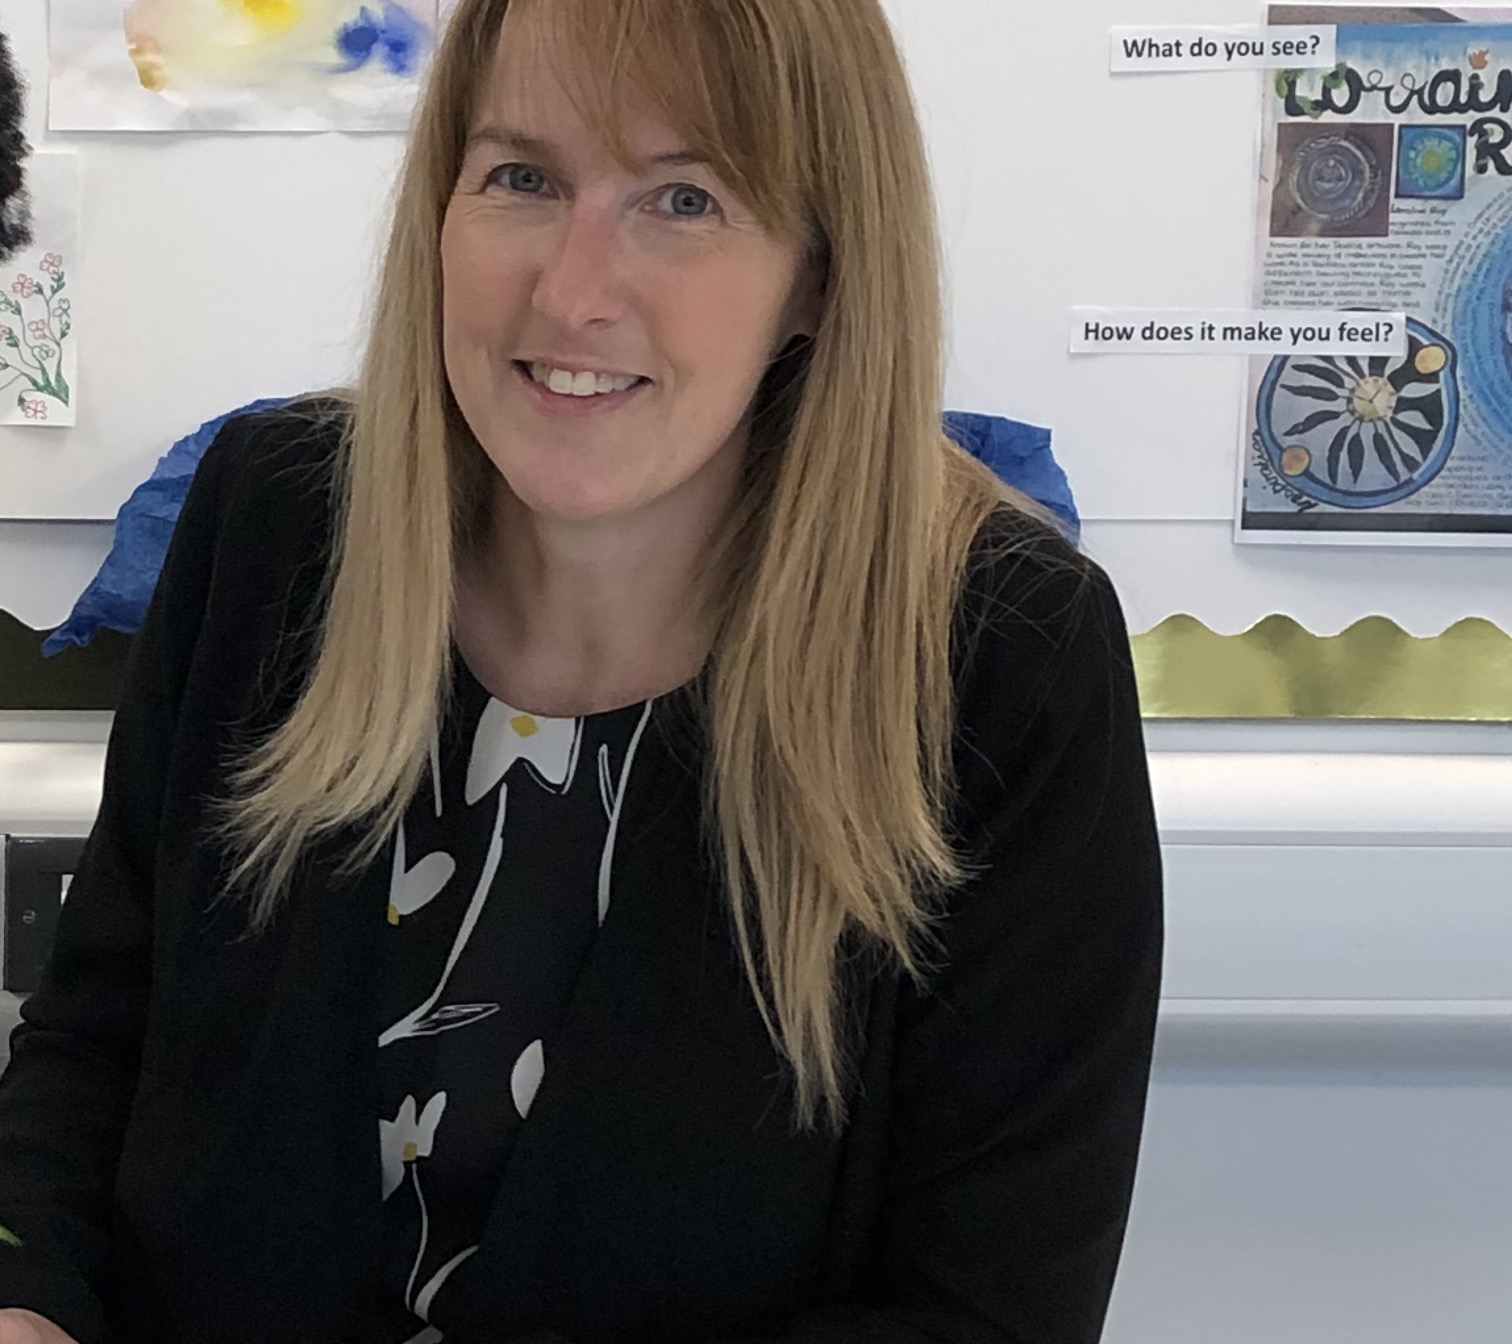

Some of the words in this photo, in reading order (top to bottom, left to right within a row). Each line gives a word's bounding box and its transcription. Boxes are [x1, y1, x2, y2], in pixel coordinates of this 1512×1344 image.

[1122, 37, 1183, 59] What
[1189, 36, 1218, 58] do
[1224, 41, 1265, 61] you
[1270, 34, 1321, 56] see?
[1083, 322, 1135, 343] How
[1141, 321, 1194, 342] does
[1200, 321, 1216, 341] it
[1222, 321, 1283, 342] make
[1289, 326, 1331, 346] you
[1338, 321, 1394, 343] feel?
